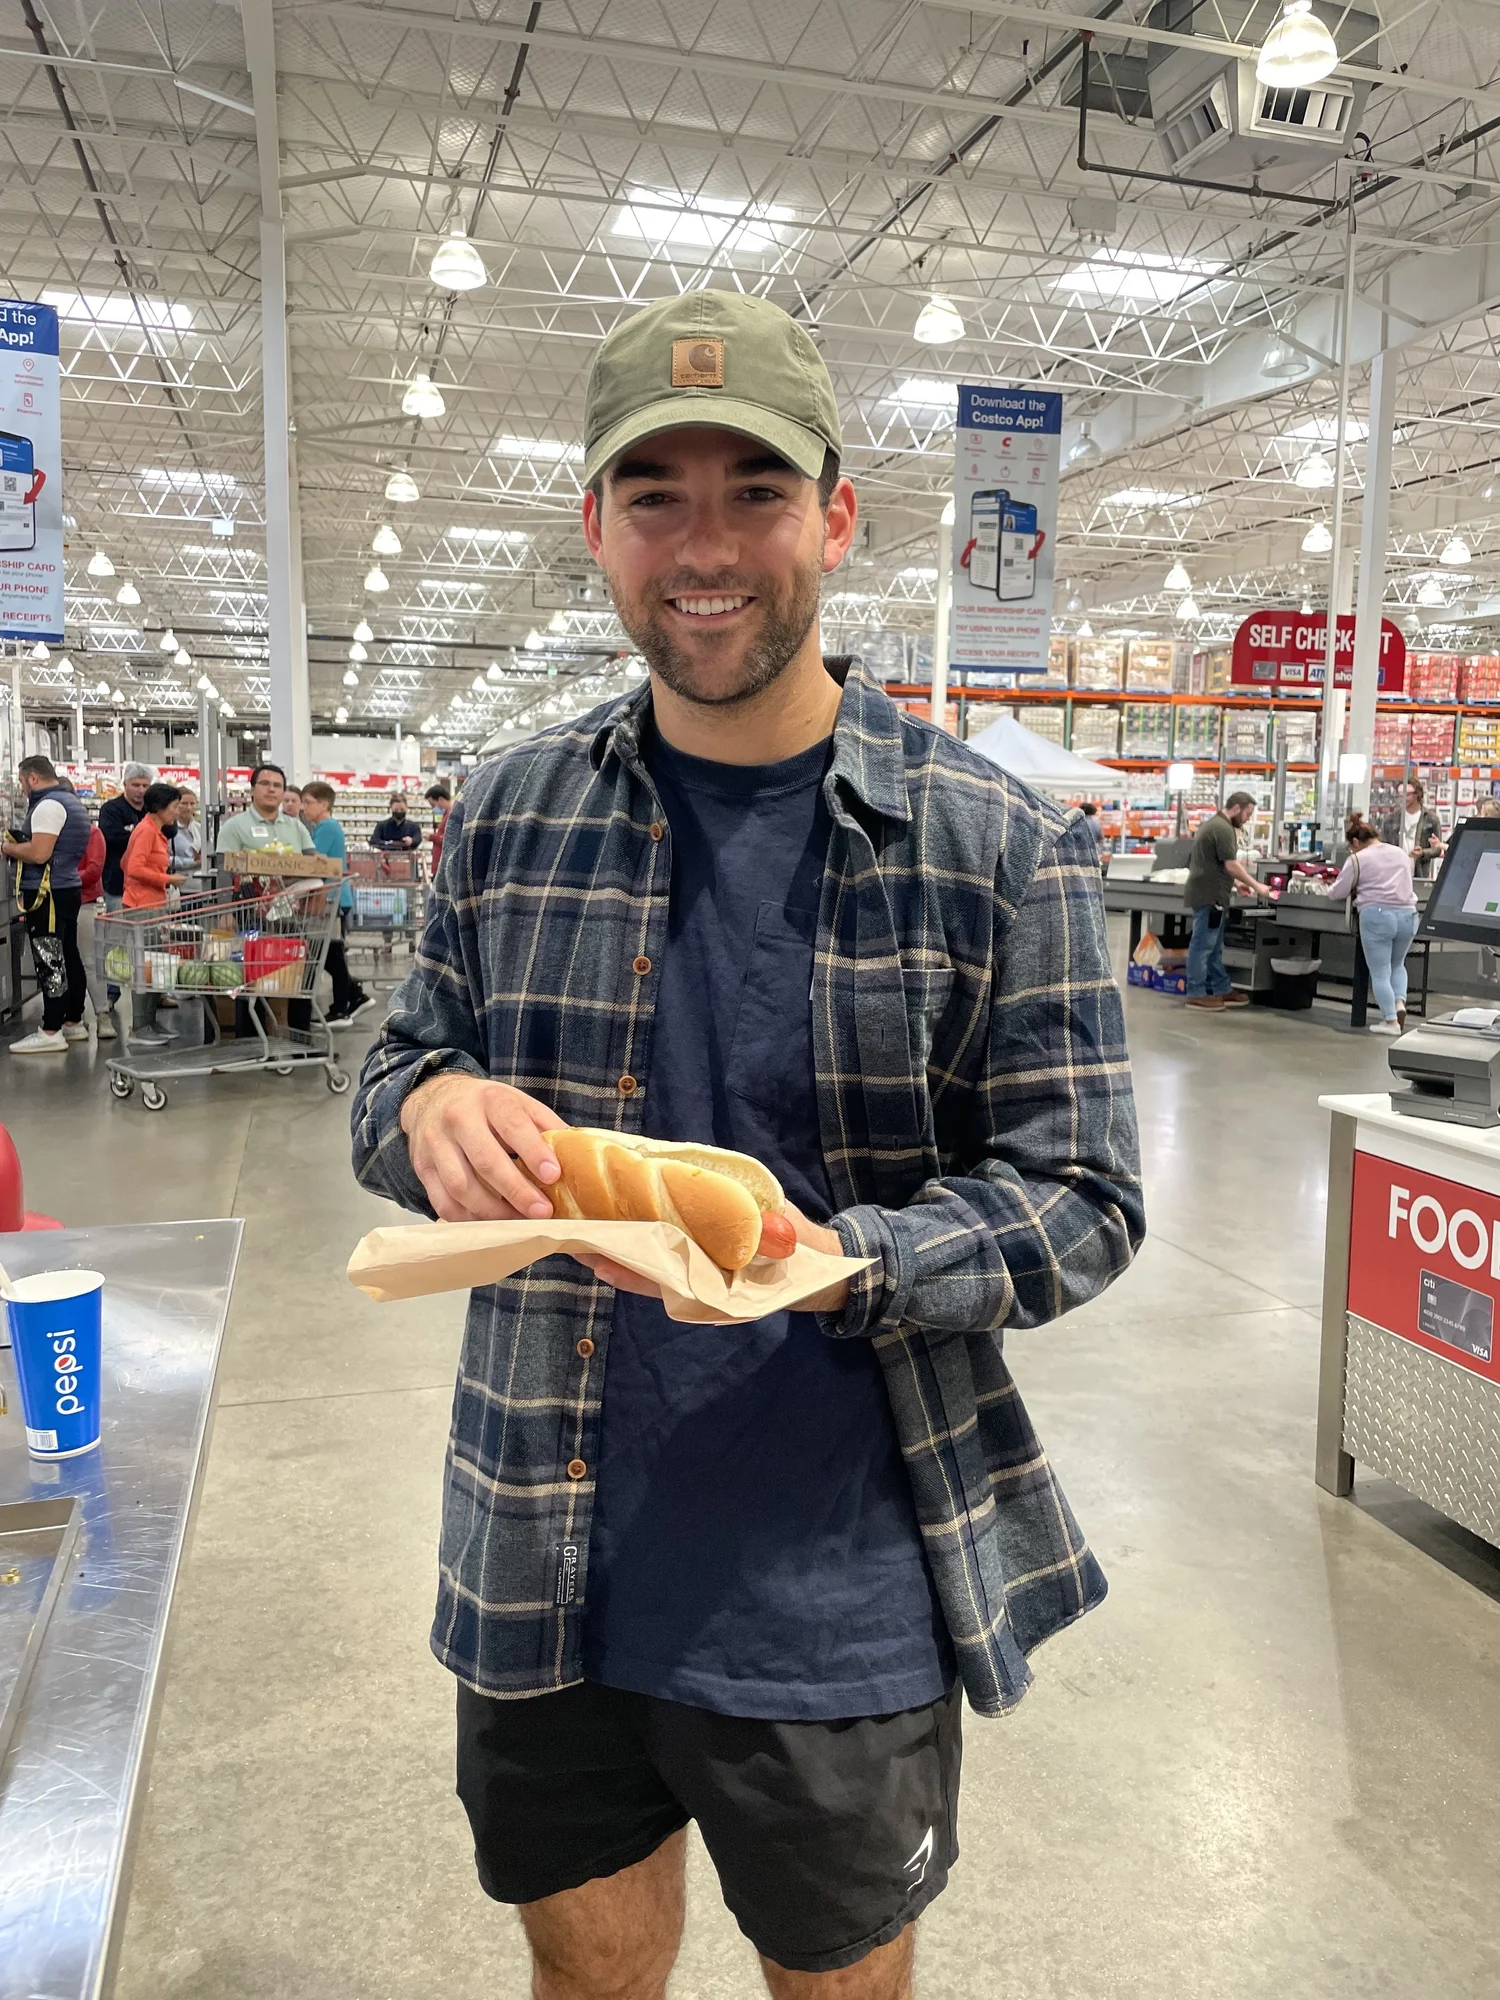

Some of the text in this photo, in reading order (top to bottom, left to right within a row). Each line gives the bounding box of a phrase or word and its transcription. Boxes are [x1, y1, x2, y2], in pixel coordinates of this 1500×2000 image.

[12, 311, 37, 325] the
[0, 328, 34, 346] App!
[971, 394, 1046, 411] Download the
[972, 411, 1044, 429] Costco App!
[28, 563, 56, 572] CARD
[14, 584, 49, 594] PHONE
[3, 612, 52, 622] RECEIPTS
[1249, 624, 1393, 655] SELF CHEK-T
[1284, 667, 1302, 676] VISA
[1335, 670, 1352, 681] sho
[250, 857, 306, 870] ORGANIC
[1423, 1278, 1436, 1290] citi
[1471, 1343, 1489, 1360] VISA
[46, 1328, 85, 1415] pepsi
